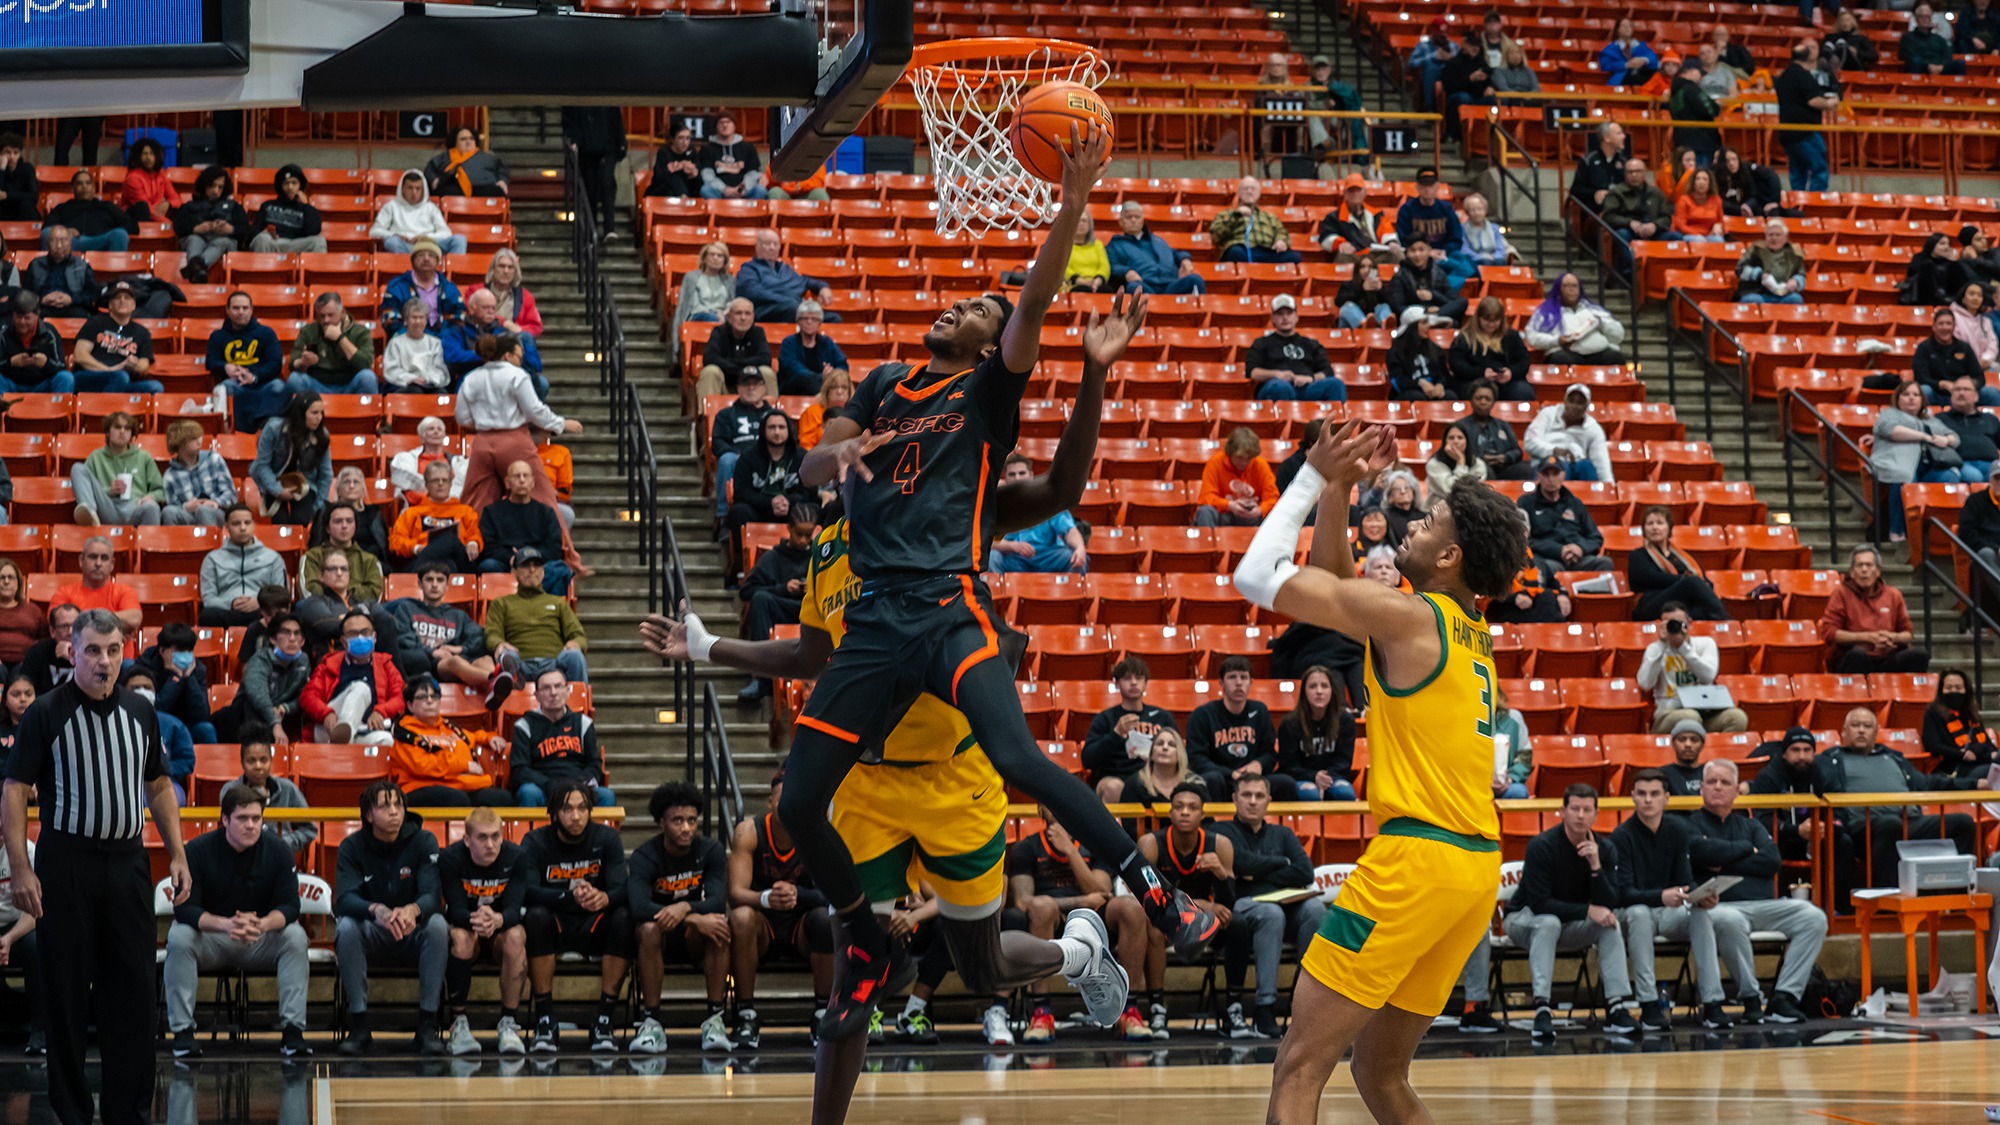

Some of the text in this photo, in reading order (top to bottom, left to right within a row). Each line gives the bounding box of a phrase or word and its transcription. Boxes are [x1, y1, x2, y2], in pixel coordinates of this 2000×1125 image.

[1069, 96, 1111, 125] ELITE
[412, 114, 434, 136] G
[684, 118, 704, 139] H
[1385, 131, 1404, 151] H
[224, 339, 259, 366] Cal
[874, 413, 965, 436] PACIFIC
[893, 442, 921, 494] 4
[1472, 659, 1494, 739] 3
[538, 735, 582, 759] TIGERS
[1214, 726, 1256, 748] PACIFIC
